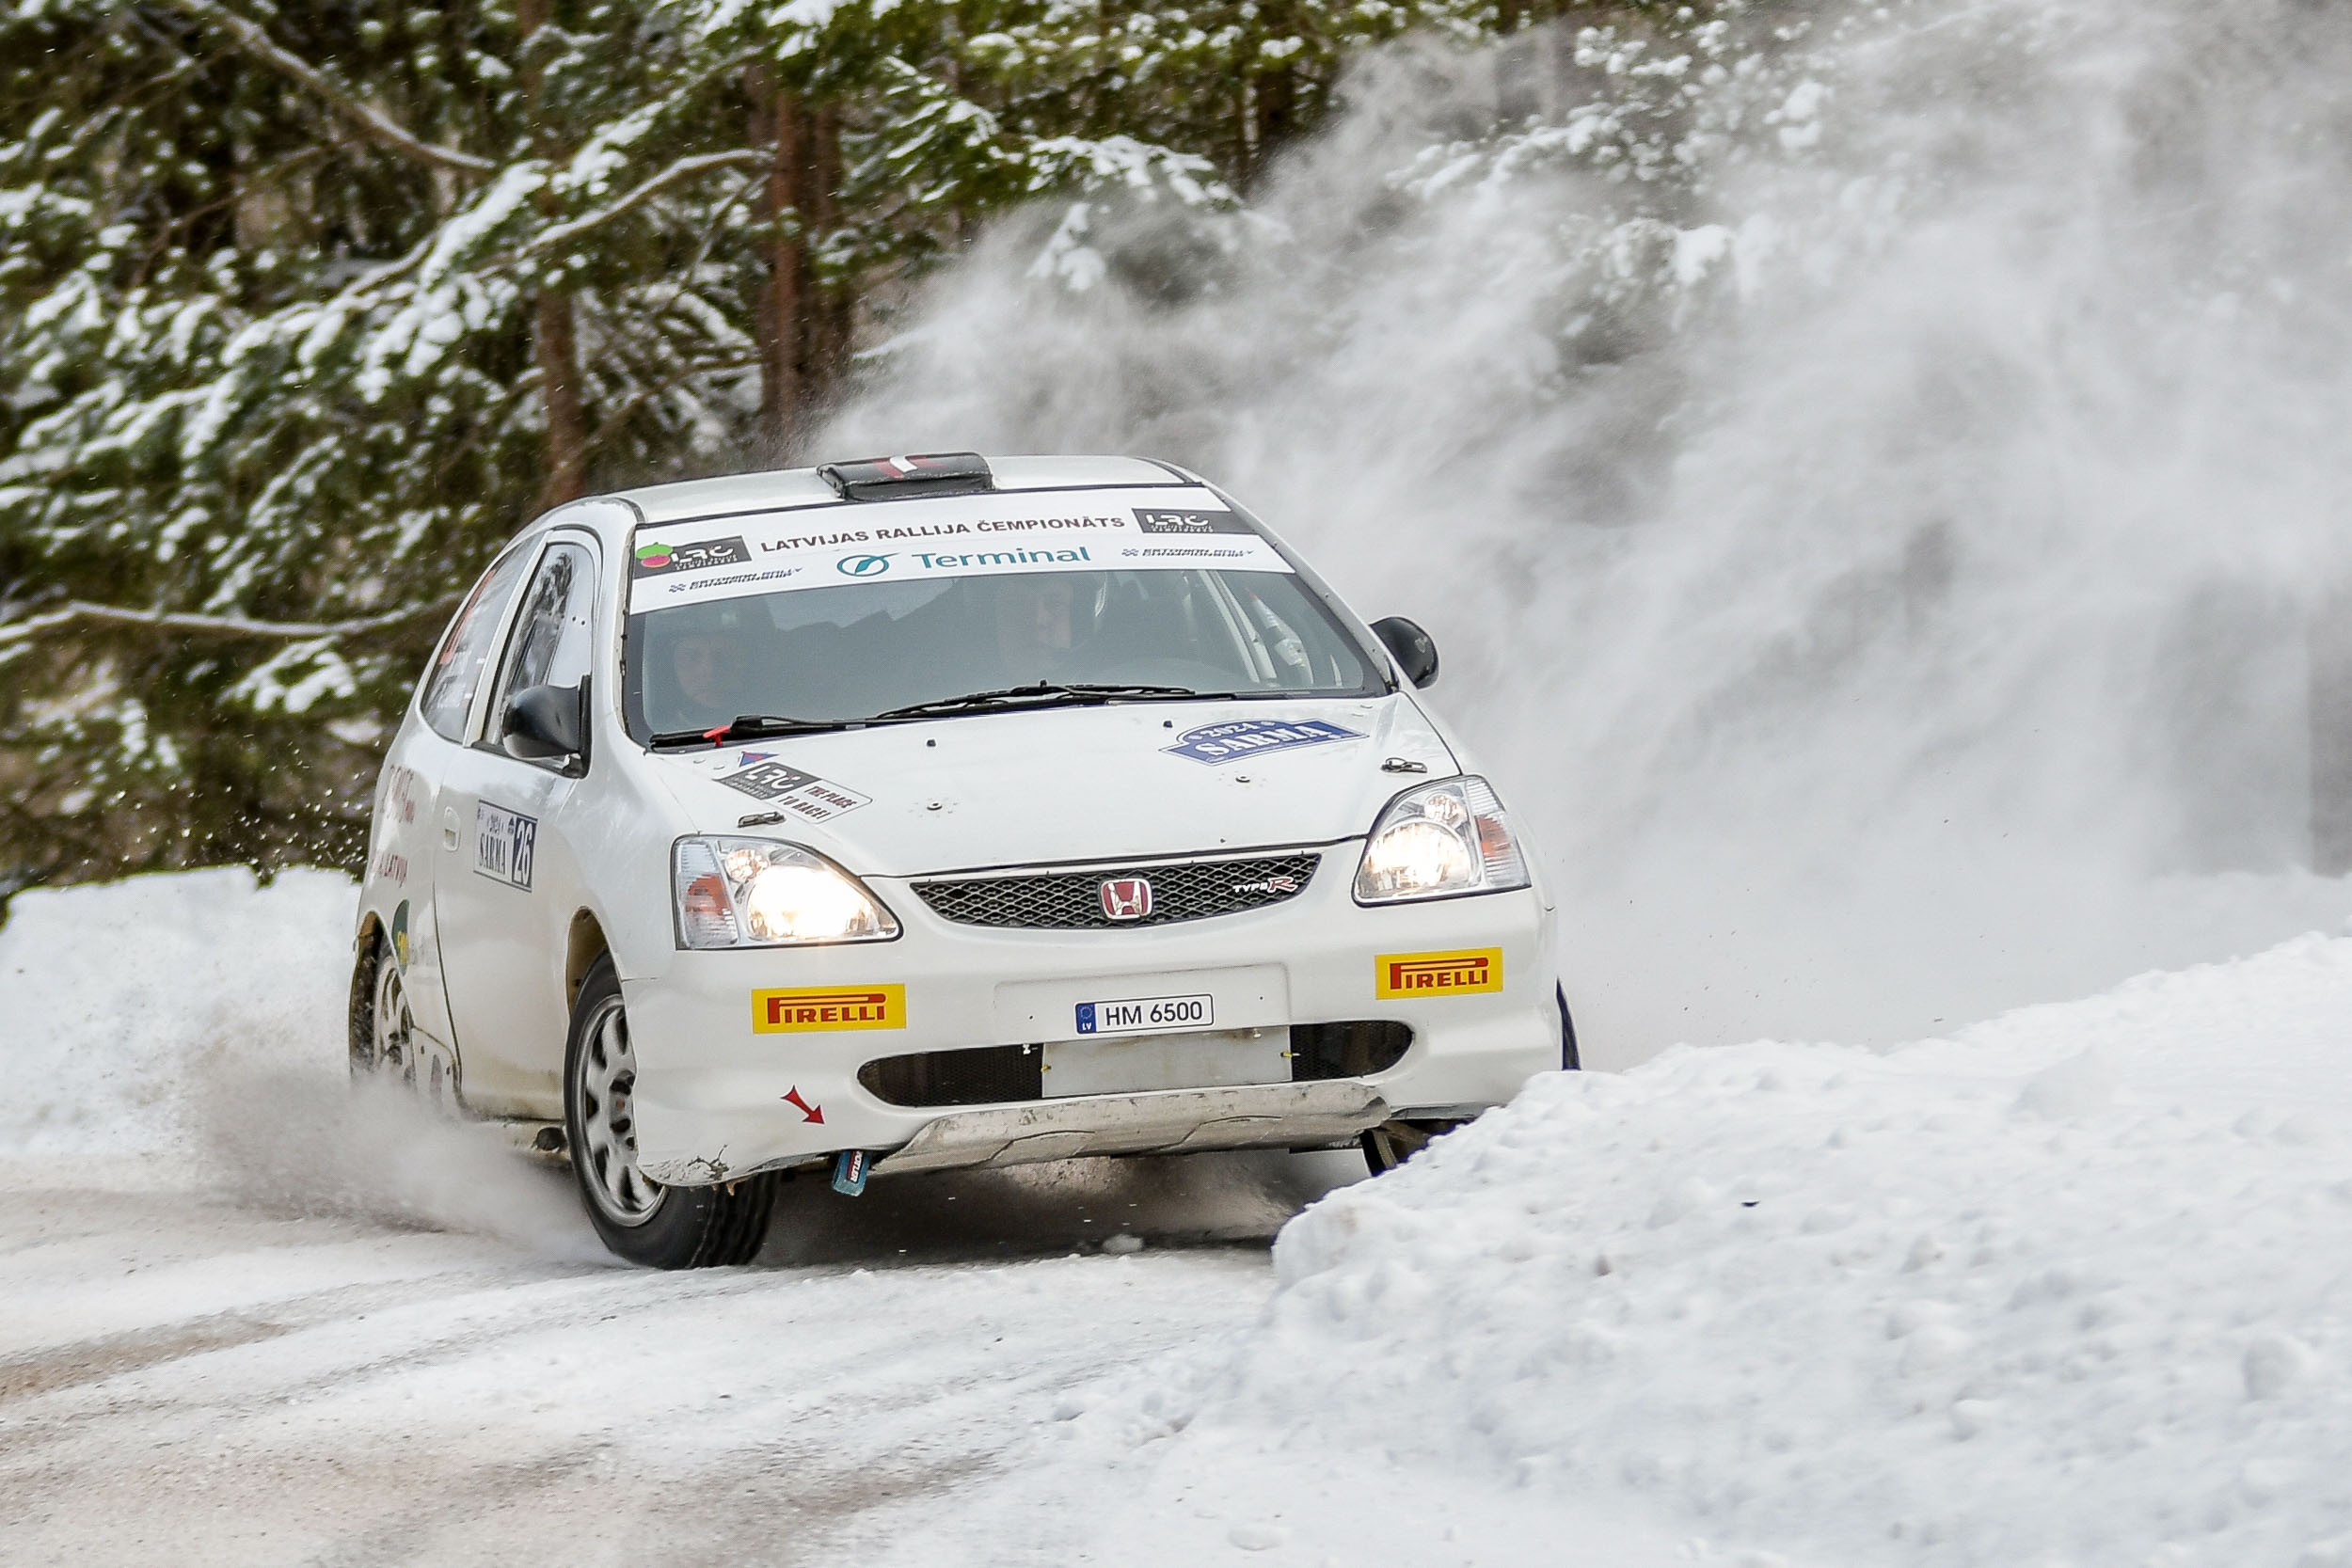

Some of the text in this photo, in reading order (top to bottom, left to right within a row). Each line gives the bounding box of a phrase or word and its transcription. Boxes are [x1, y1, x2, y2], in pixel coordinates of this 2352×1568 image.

[760, 515, 1125, 553] LATVIJAS RALLIJA ČEMPIONĀTS
[912, 546, 1091, 570] Terminal
[1195, 725, 1331, 756] SARMA
[1208, 721, 1256, 738] 2024
[777, 796, 796, 806] TO
[803, 785, 858, 809] THE PLACE
[479, 832, 506, 875] SARMA
[514, 819, 533, 885] 26
[1266, 877, 1298, 894] R
[1390, 957, 1489, 990] PIRELLI
[767, 993, 886, 1024] PIRELLI
[1105, 1001, 1202, 1026] HM 6500
[1082, 1022, 1092, 1031] LV
